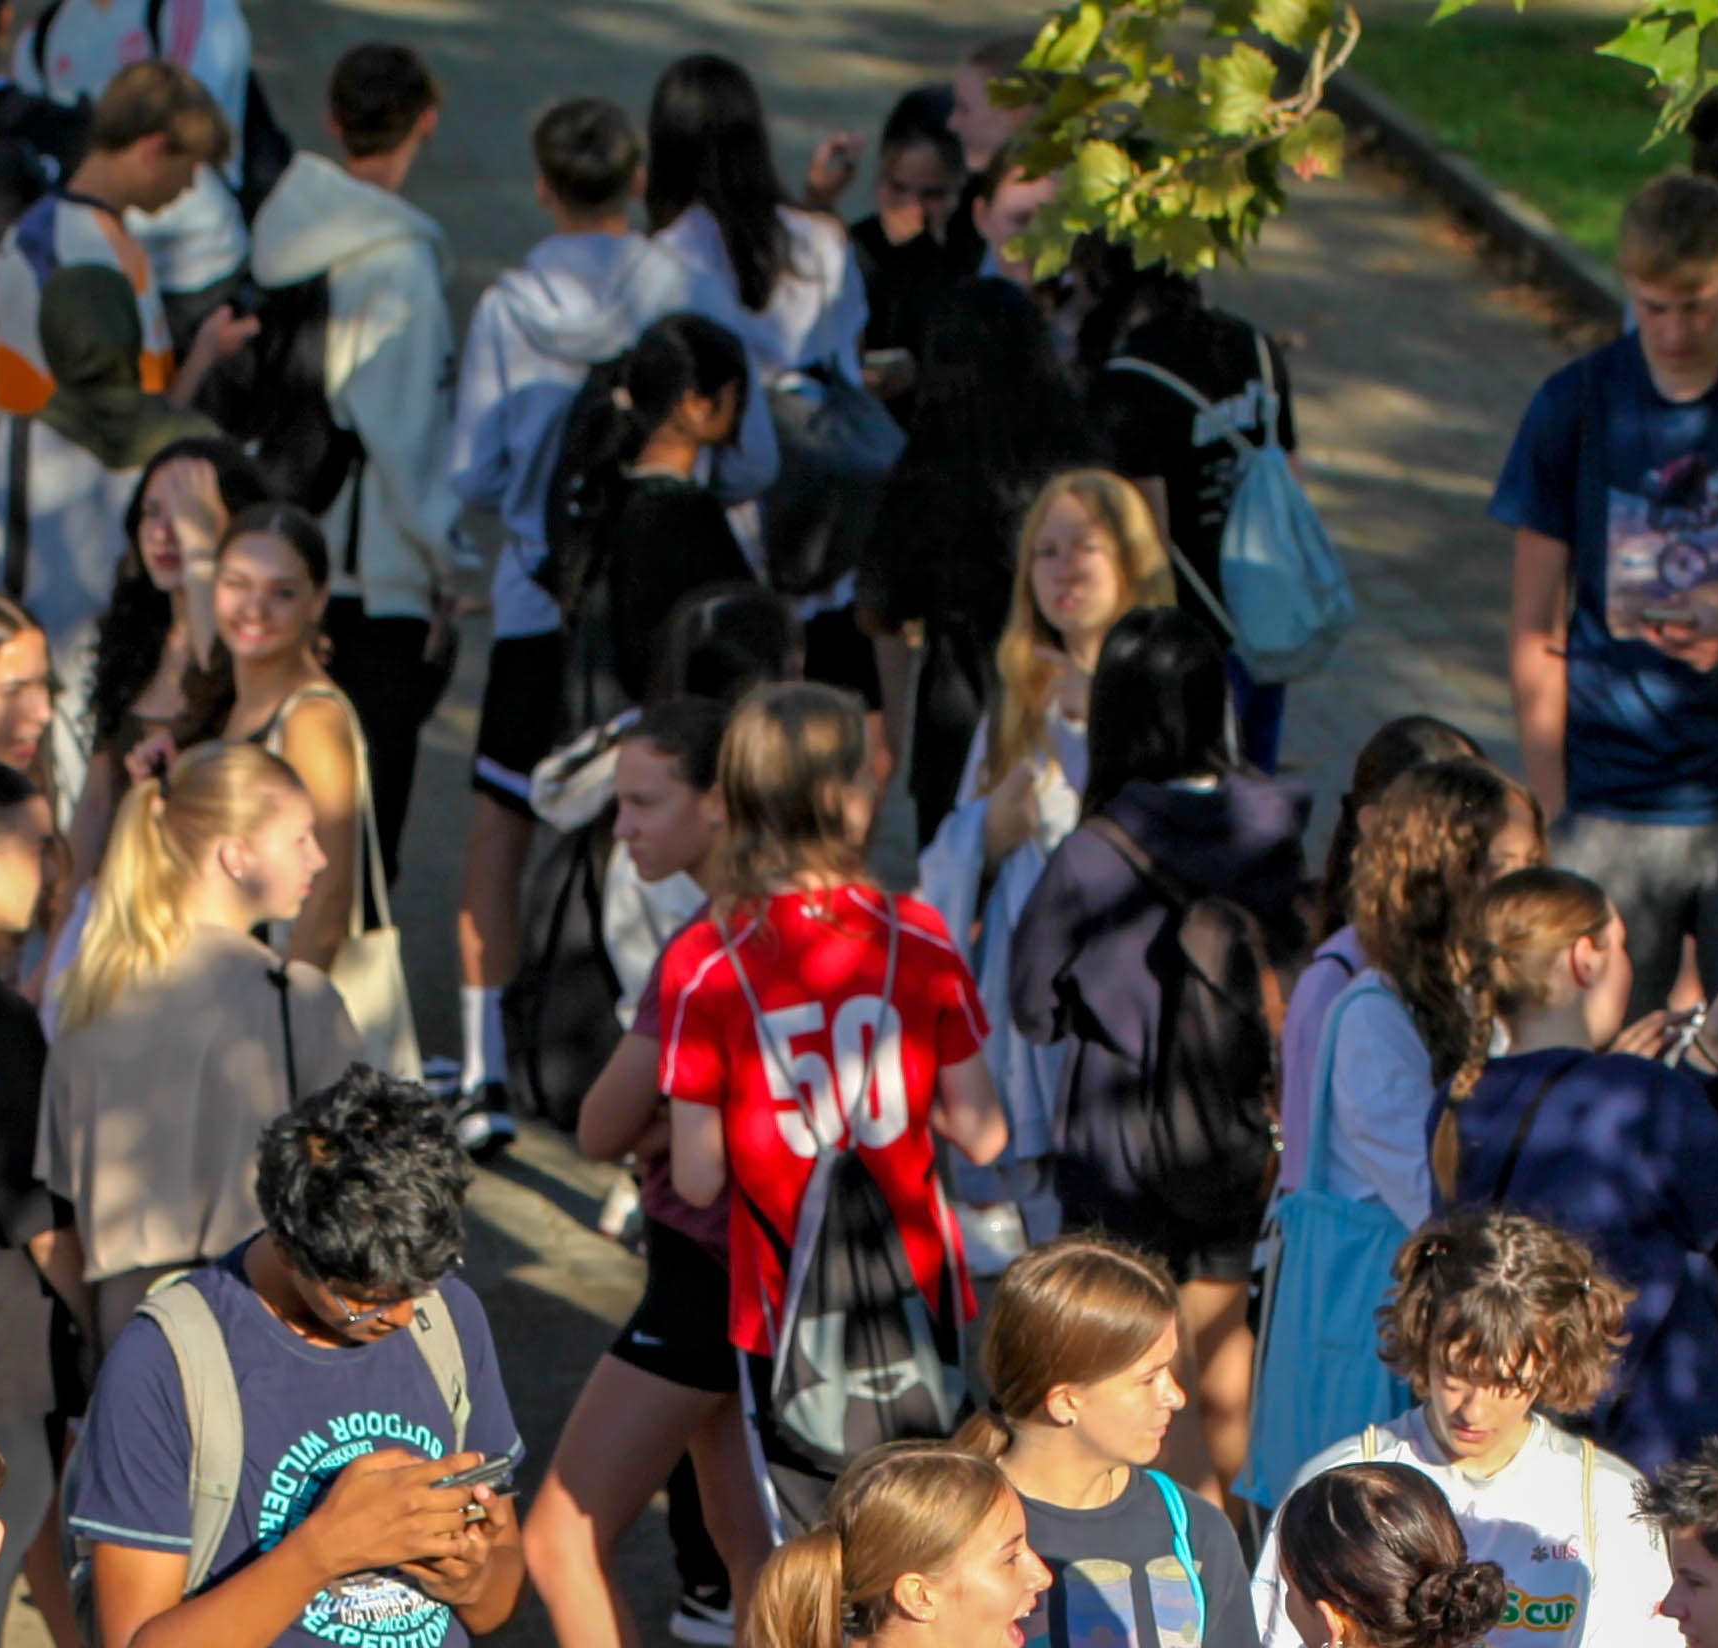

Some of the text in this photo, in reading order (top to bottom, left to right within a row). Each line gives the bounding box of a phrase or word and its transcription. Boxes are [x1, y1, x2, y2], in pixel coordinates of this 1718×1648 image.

[754, 994, 909, 1159] 50
[328, 1410, 444, 1460] OUTDOOR
[1525, 1601, 1575, 1625] CUP
